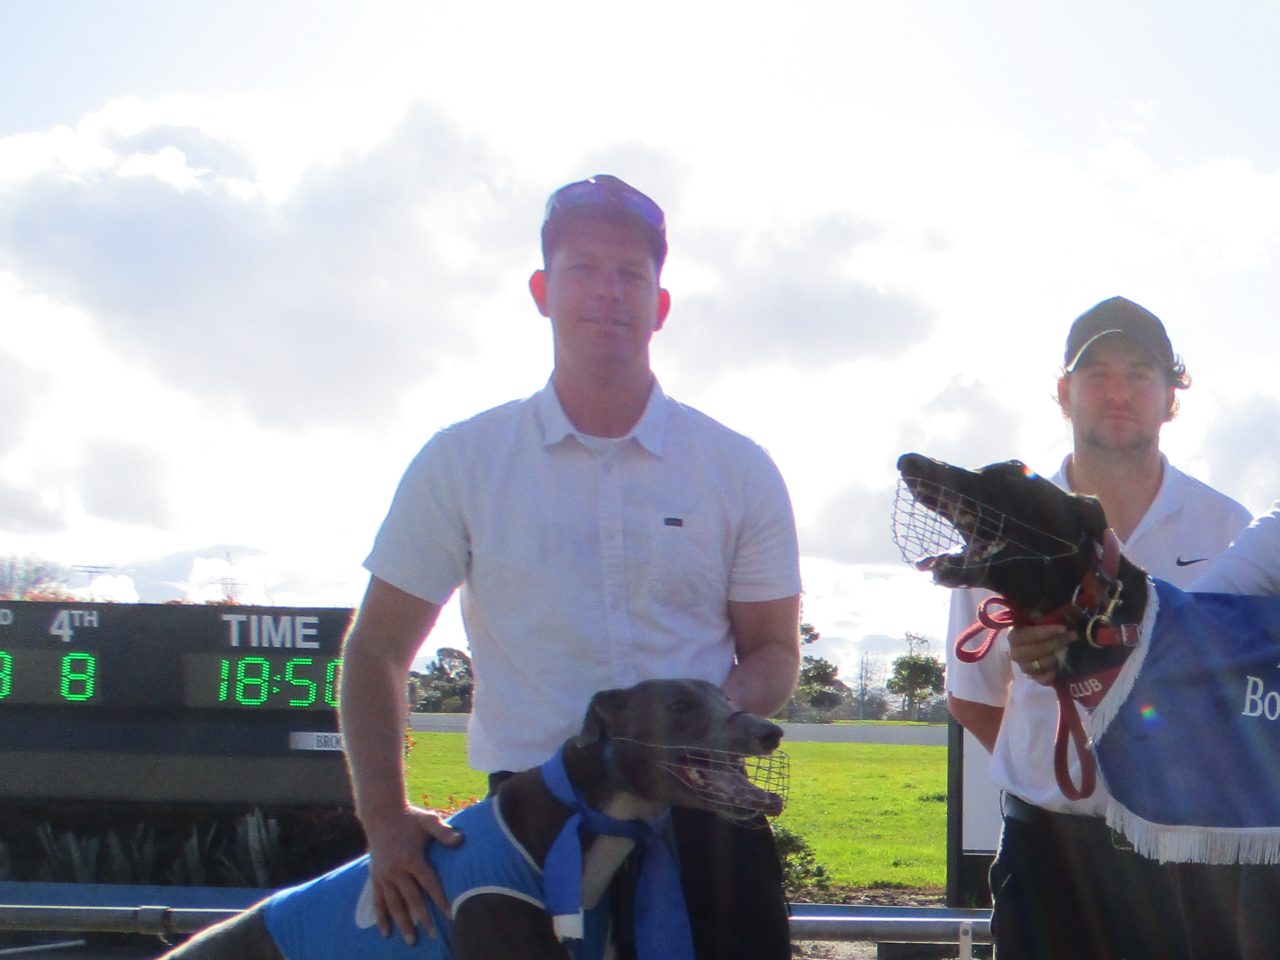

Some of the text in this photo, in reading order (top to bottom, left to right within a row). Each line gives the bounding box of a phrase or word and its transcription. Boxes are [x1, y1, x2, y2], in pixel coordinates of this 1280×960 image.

[49, 609, 99, 643] 4TH
[221, 613, 320, 649] TIME
[60, 652, 96, 701] 8
[1069, 678, 1103, 698] CLUB
